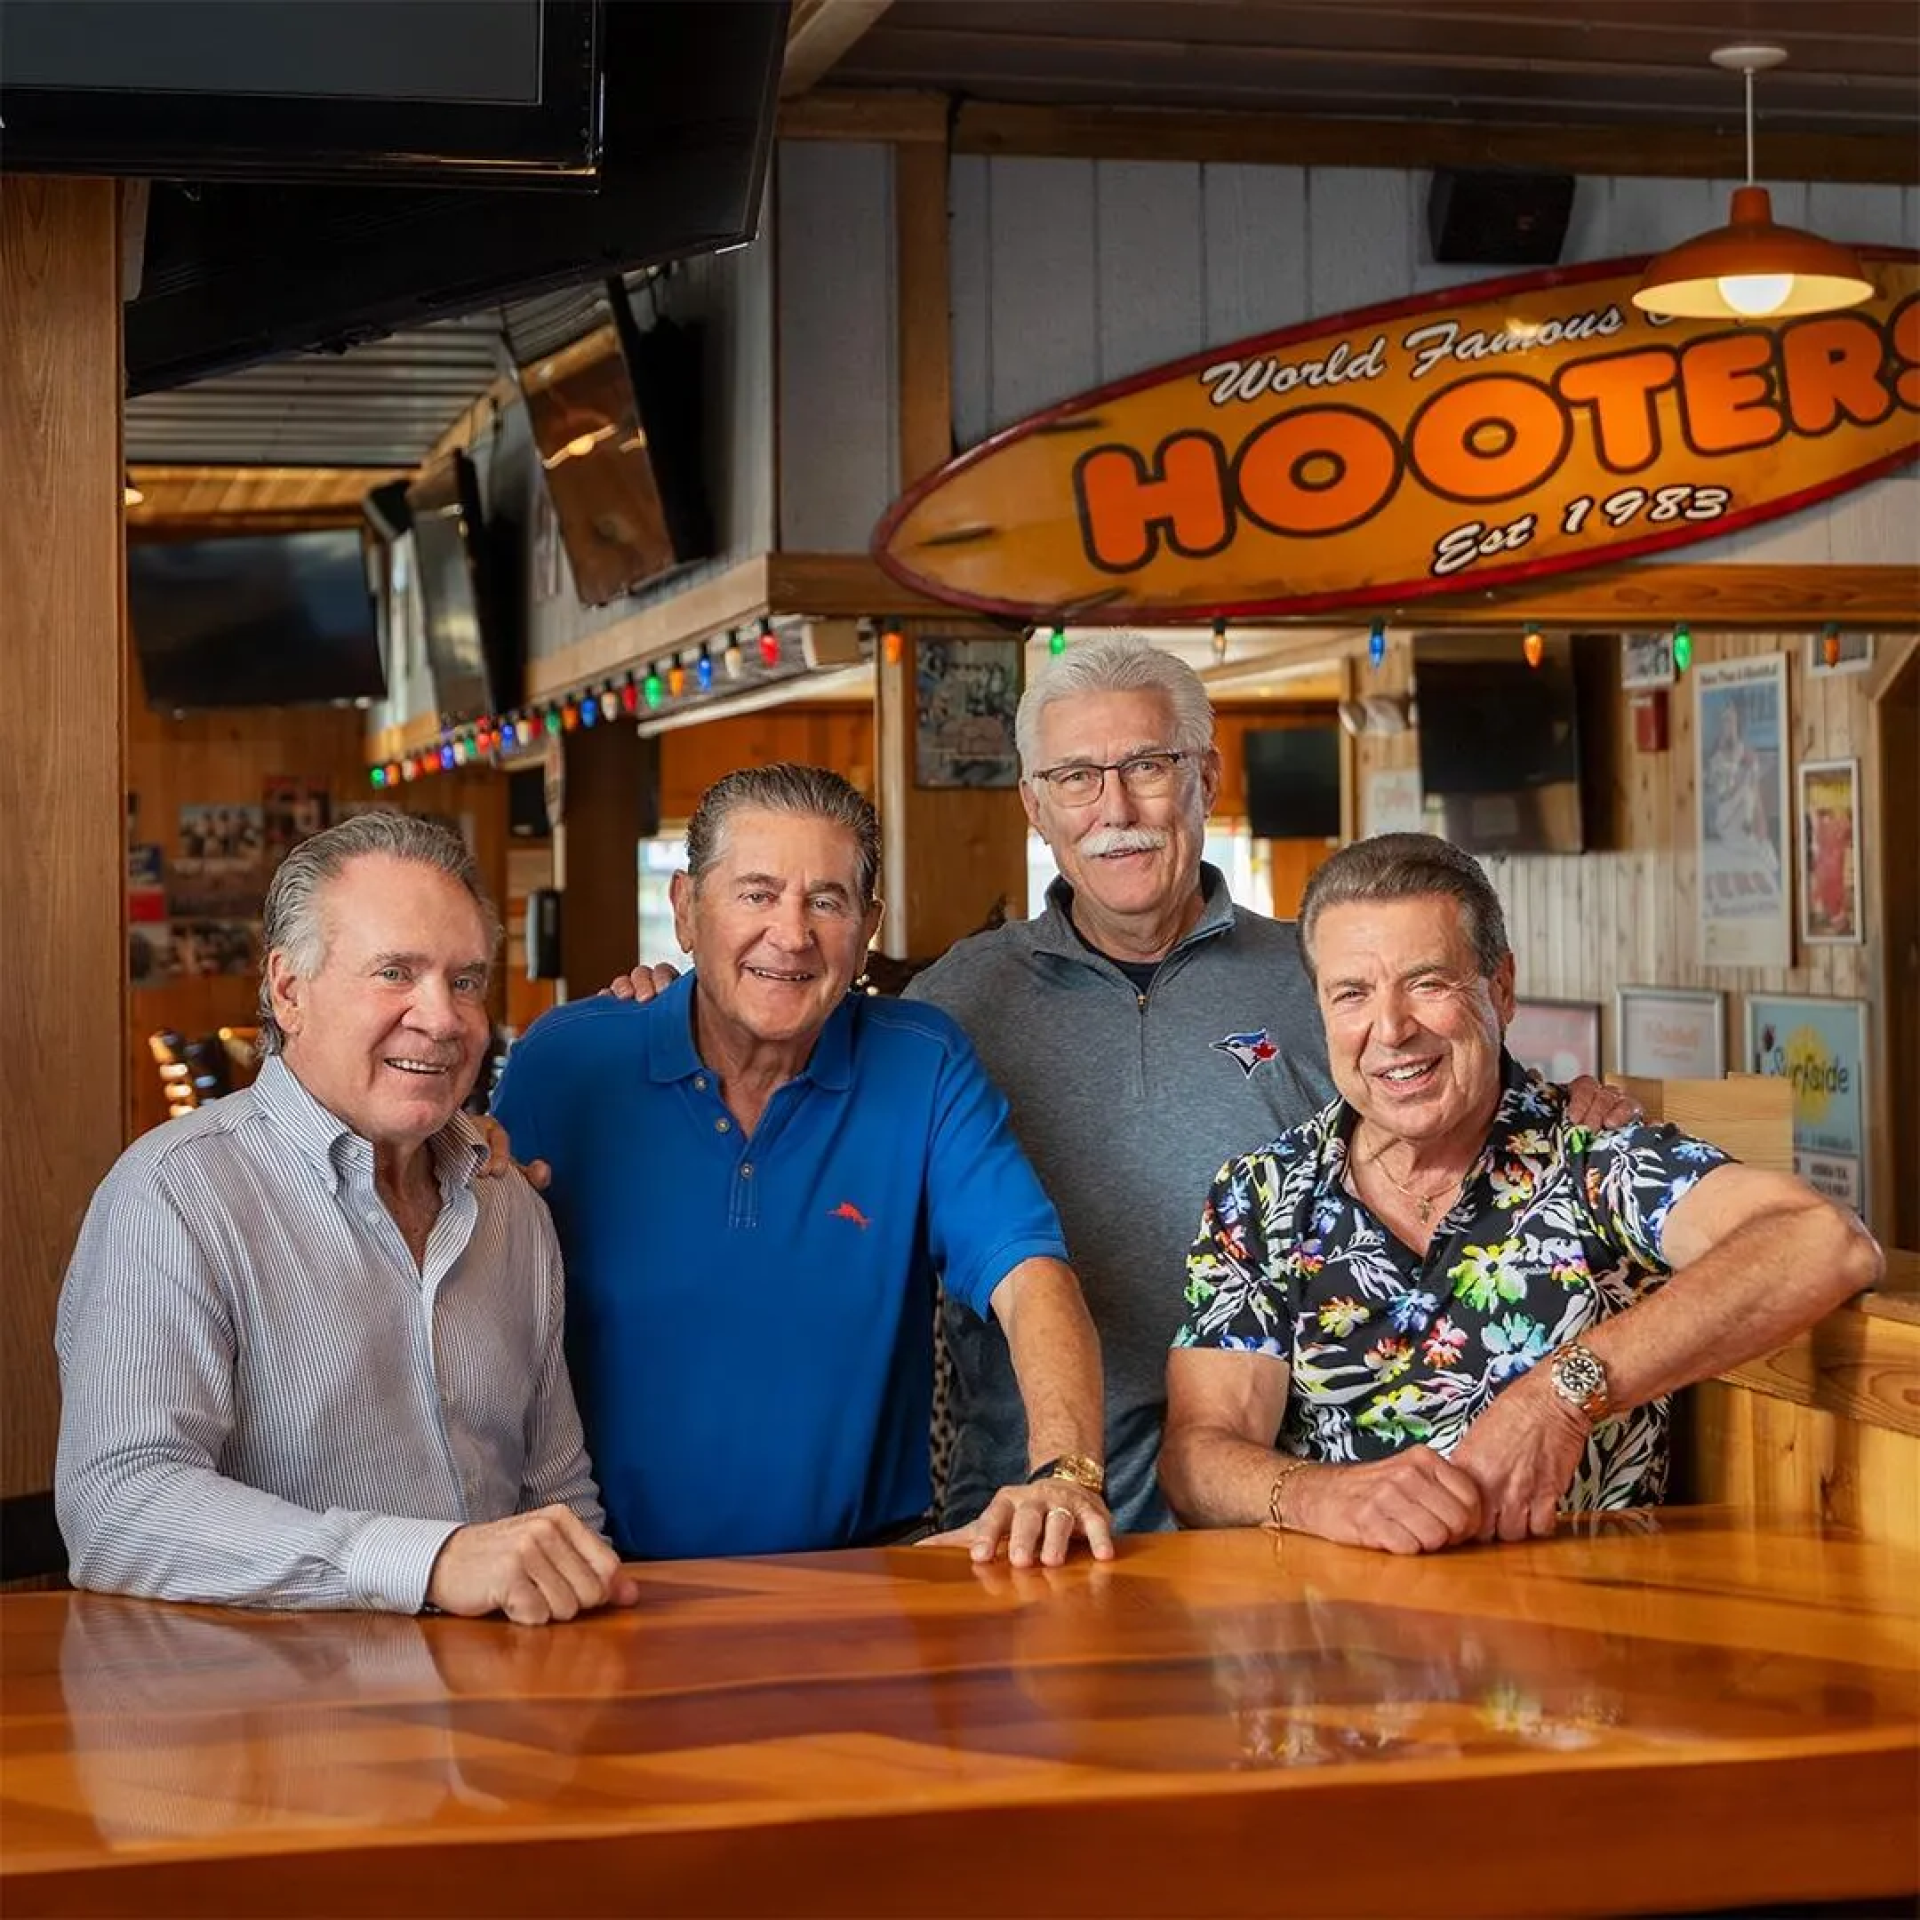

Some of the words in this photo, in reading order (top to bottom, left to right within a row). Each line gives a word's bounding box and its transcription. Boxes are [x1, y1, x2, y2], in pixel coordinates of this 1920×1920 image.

[1200, 335, 1387, 408] World
[1403, 304, 1625, 379] Famous
[1430, 514, 1537, 576] Est
[1561, 481, 1732, 534] 1983
